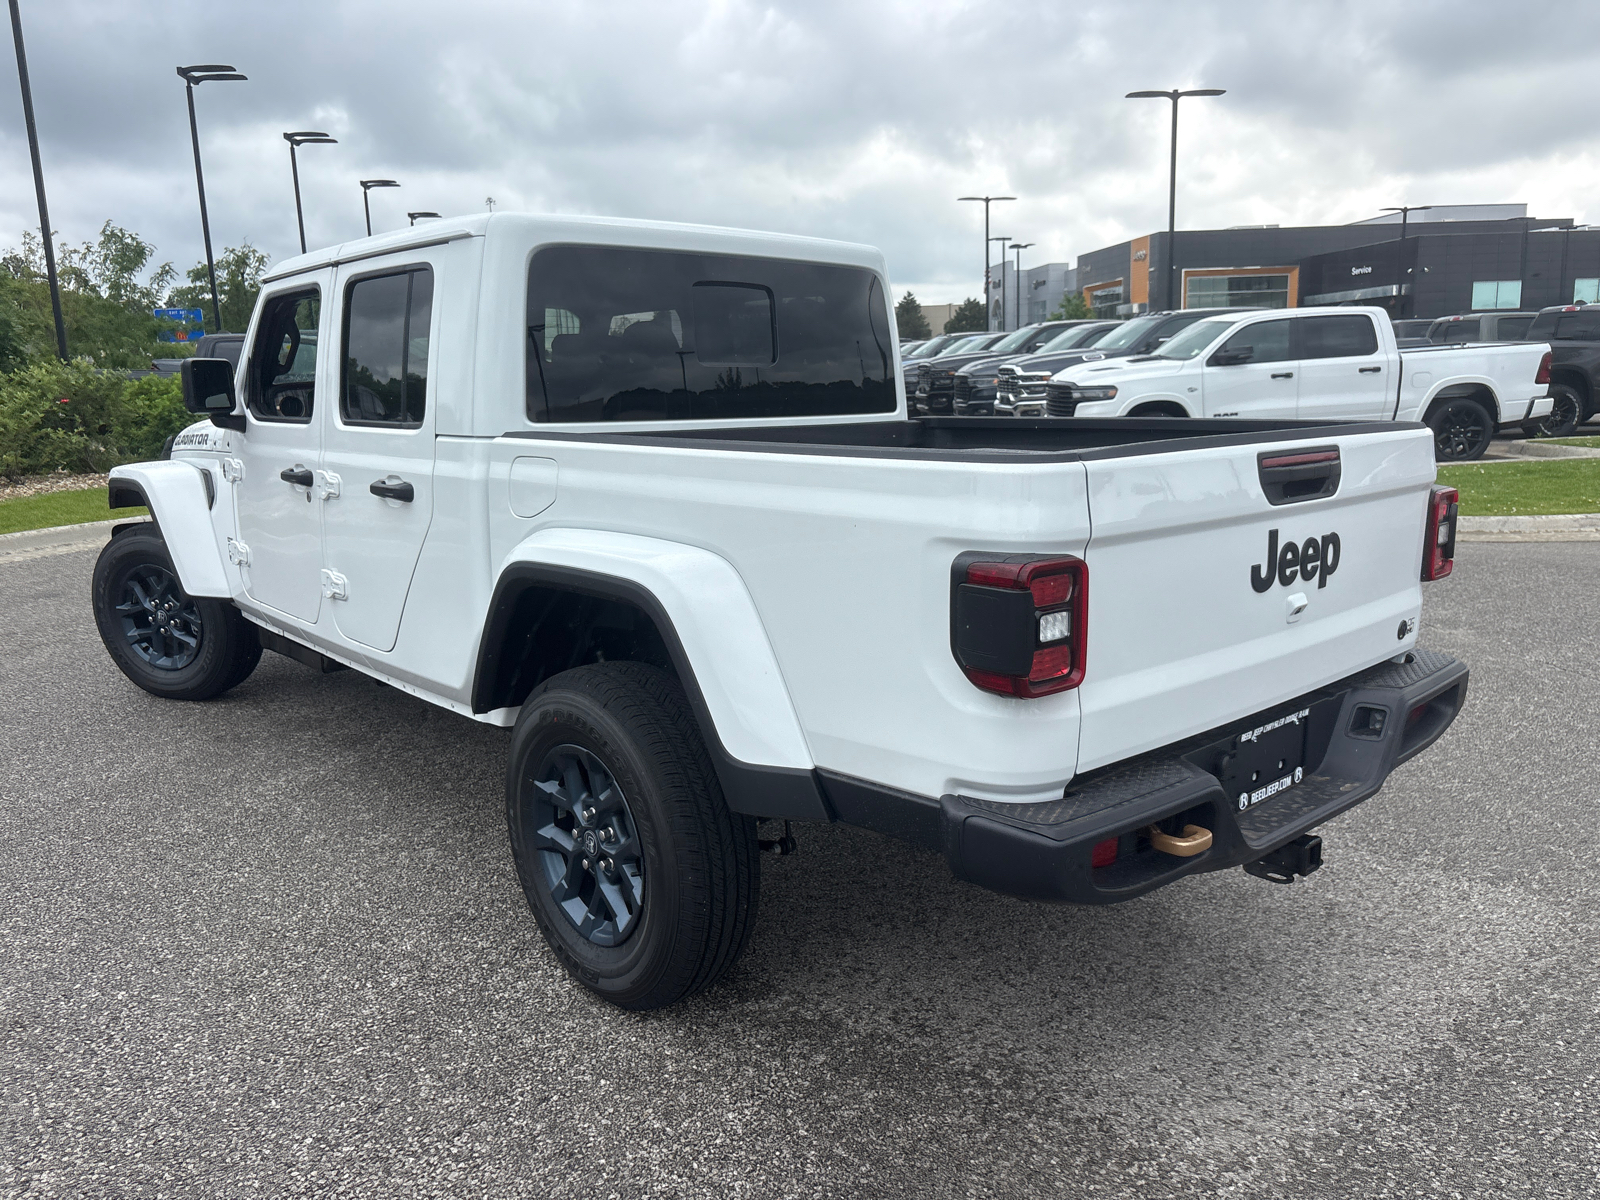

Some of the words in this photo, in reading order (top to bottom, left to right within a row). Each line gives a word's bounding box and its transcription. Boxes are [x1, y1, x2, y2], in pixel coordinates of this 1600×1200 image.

[1351, 265, 1372, 276] Service
[1250, 528, 1341, 593] Jeep
[1251, 775, 1292, 805] REEDJEEP.COM
